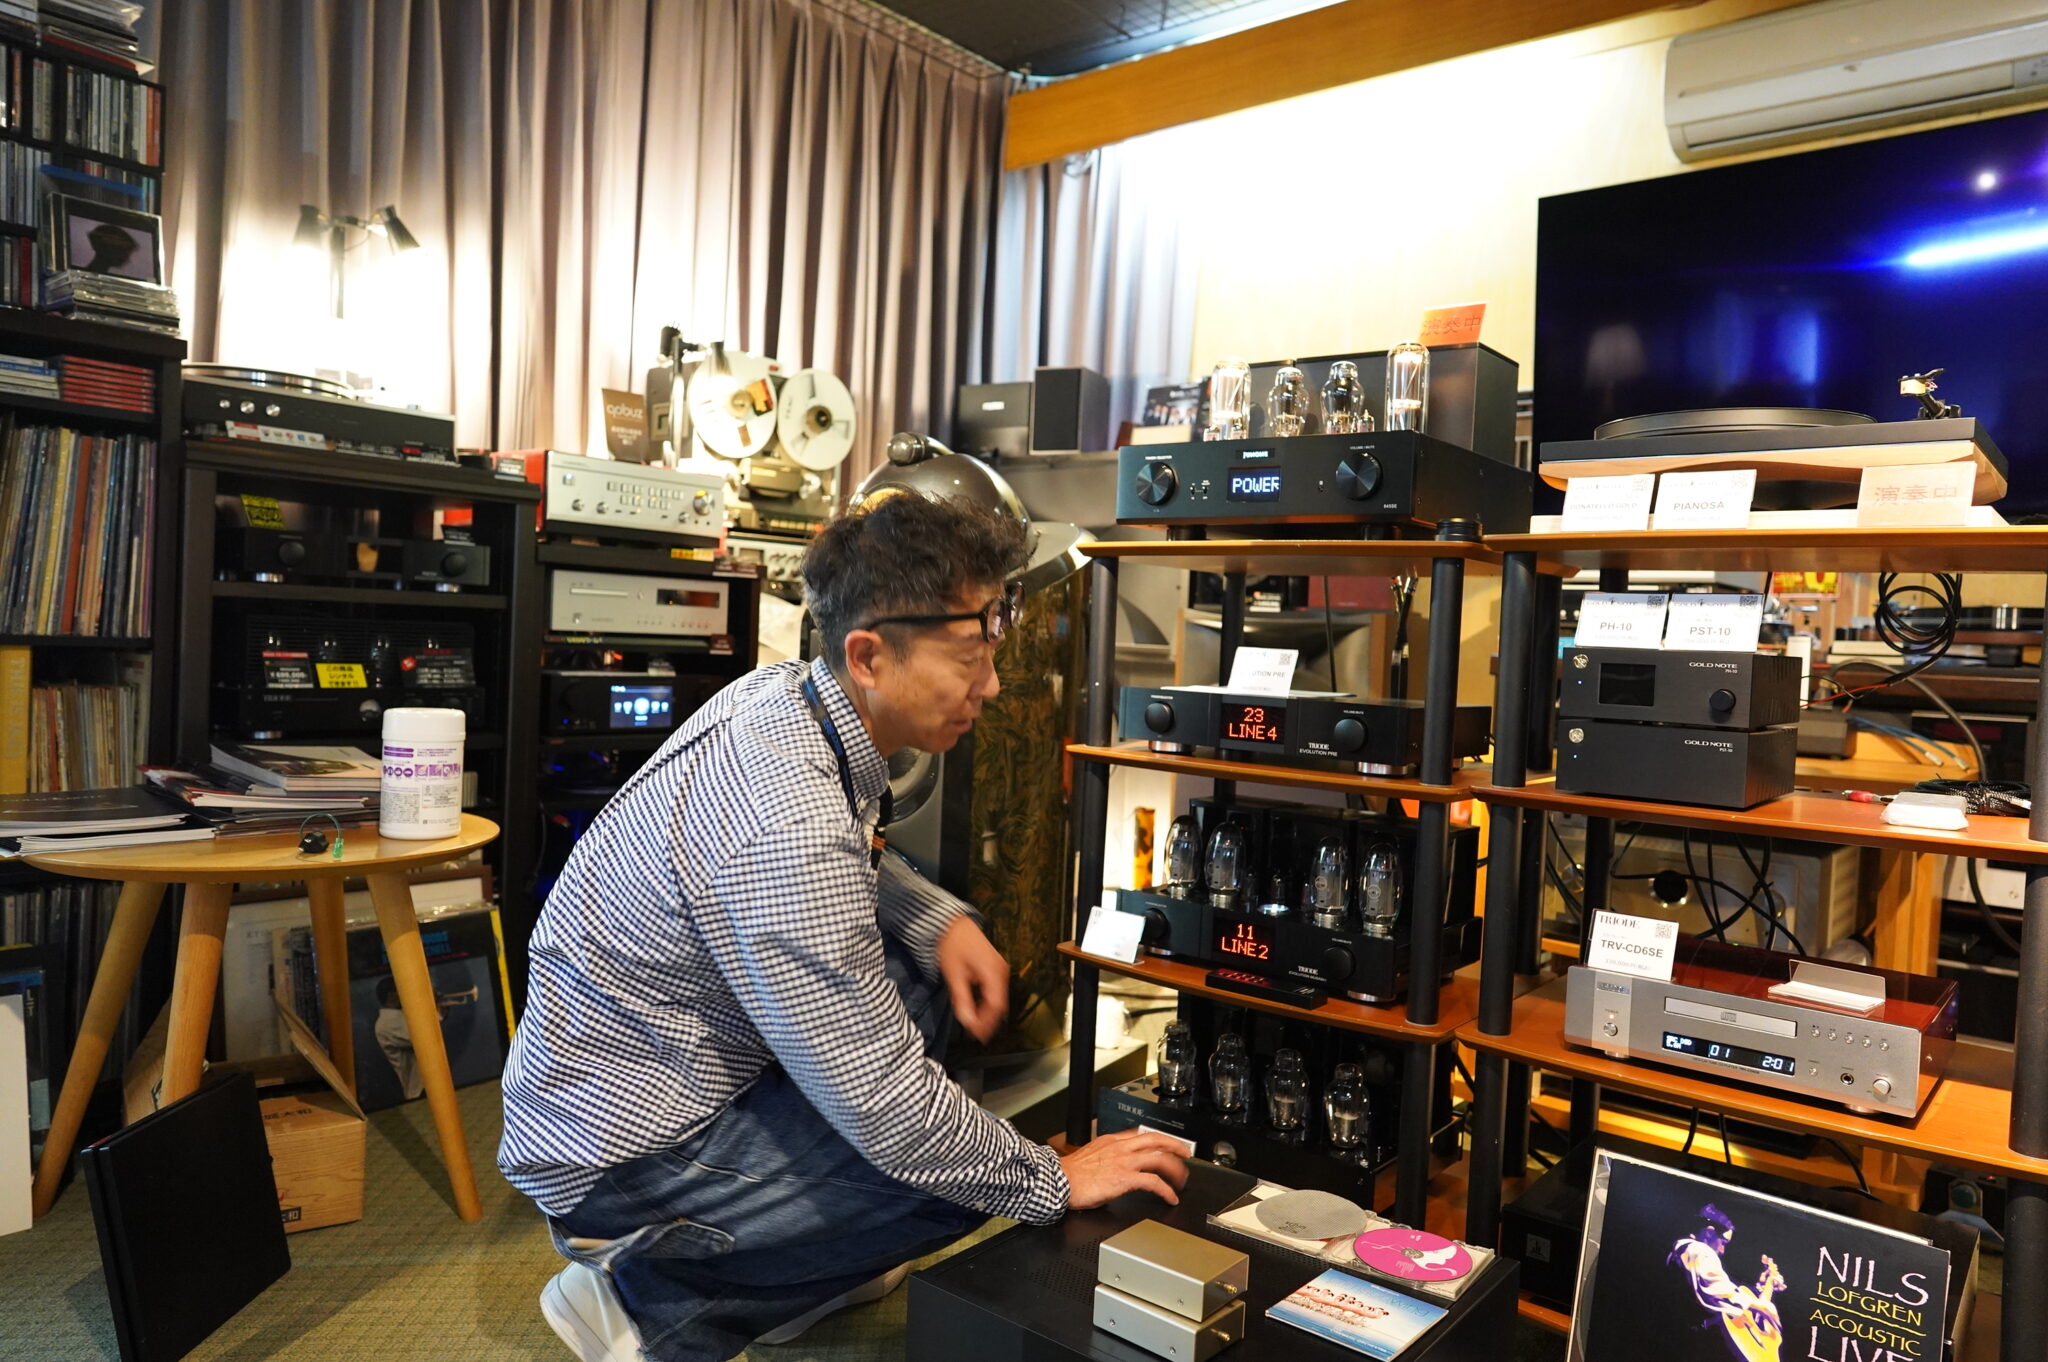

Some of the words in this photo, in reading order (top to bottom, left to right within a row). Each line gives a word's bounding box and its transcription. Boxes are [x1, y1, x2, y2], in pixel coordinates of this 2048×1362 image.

[1232, 476, 1280, 493] POWER
[1873, 484, 1958, 507] 演奏中
[1673, 501, 1725, 511] PIANOSA
[1600, 621, 1633, 632] PH-10
[1689, 626, 1732, 636] PST-10
[1688, 661, 1714, 669] GOLD
[1243, 707, 1264, 722] 23
[1308, 742, 1330, 751] TRIODE
[1684, 739, 1709, 747] GOLD
[1299, 748, 1327, 756] EVOLUTION
[1237, 923, 1254, 939] 11
[1601, 939, 1665, 958] TRV-CD6SE
[1761, 1055, 1795, 1073] 2:01
[1816, 1245, 1929, 1306] NILS
[1817, 1281, 1922, 1326] LOFGREN
[1809, 1309, 1922, 1356] ACOUSTIC
